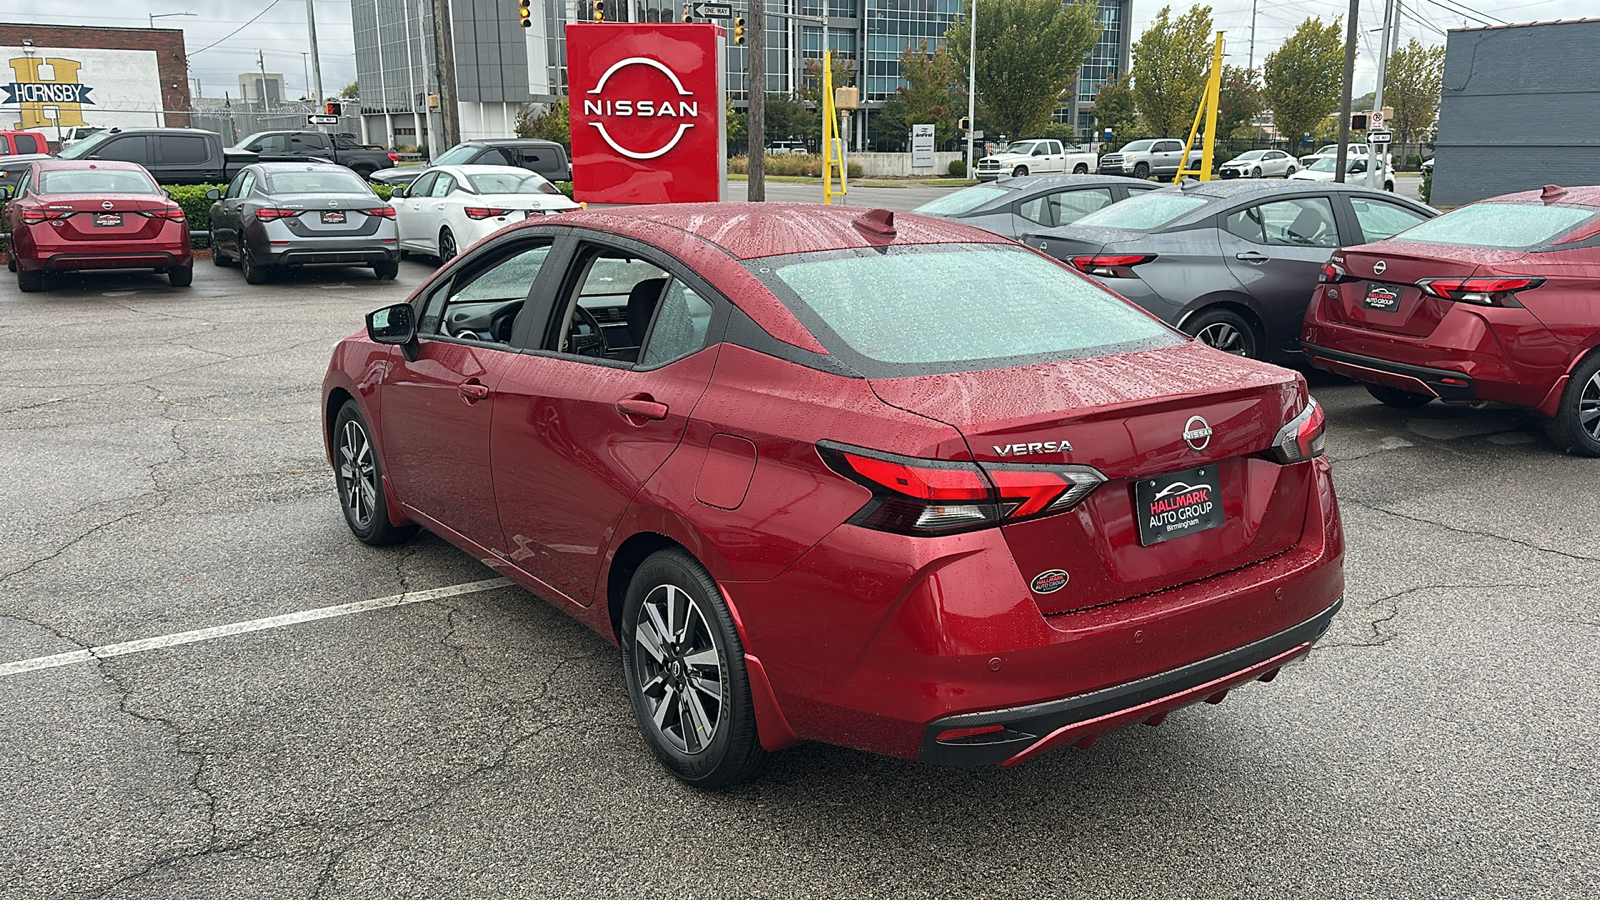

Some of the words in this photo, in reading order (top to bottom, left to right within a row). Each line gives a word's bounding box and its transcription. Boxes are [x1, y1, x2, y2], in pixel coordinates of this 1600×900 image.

[14, 83, 83, 102] HORNSBY
[584, 99, 698, 117] NISSAN
[1368, 292, 1394, 300] HALLMARK
[1182, 427, 1213, 440] NISSAN
[992, 440, 1074, 457] VERSA
[1150, 489, 1209, 515] HALLMARK
[1149, 511, 1177, 528] AUTO
[1178, 501, 1213, 520] GROUP
[1166, 518, 1200, 532] Birmingham
[1036, 575, 1064, 585] HALLMARK
[1048, 579, 1066, 587] GROUP
[718, 648, 729, 721] KUMHO
